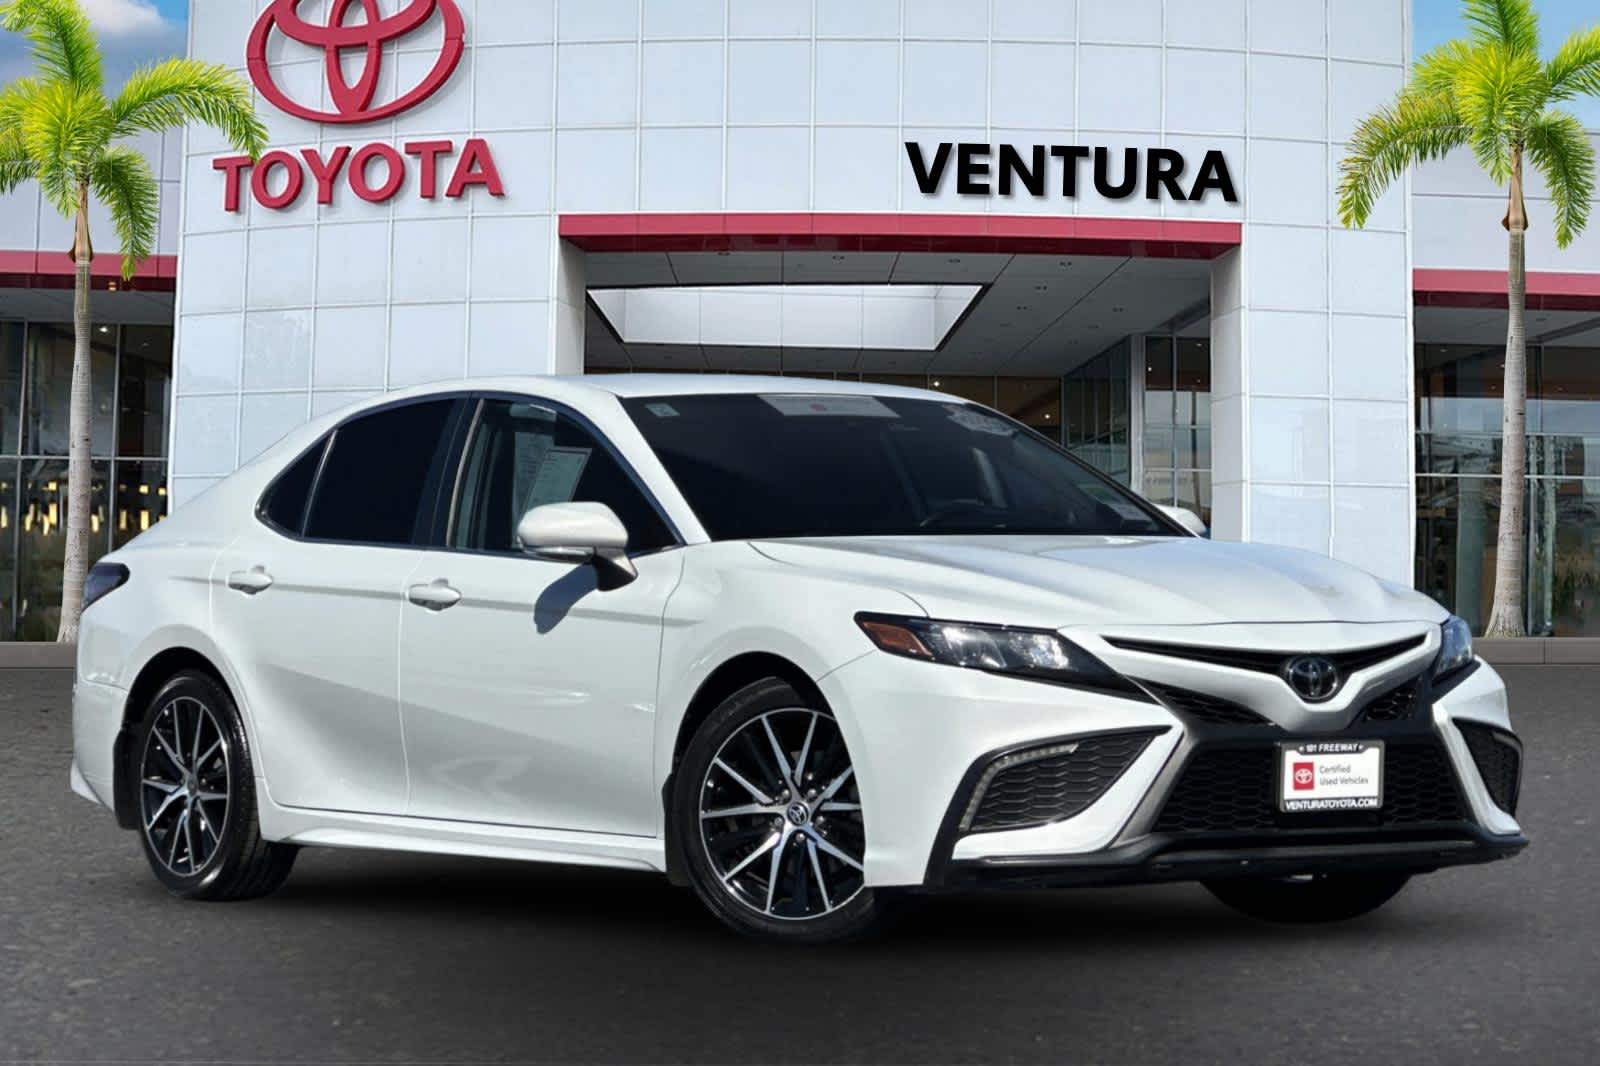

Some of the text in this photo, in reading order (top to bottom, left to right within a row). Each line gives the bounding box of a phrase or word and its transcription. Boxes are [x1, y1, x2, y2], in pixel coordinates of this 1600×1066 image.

[213, 138, 505, 212] TOYOTA
[904, 141, 1239, 202] VENTURA
[1318, 743, 1358, 752] FREEWAY
[1319, 765, 1351, 774] Certified
[1340, 777, 1368, 785] Vehicles
[1285, 798, 1378, 810] VENTURATOYOTA.COM
